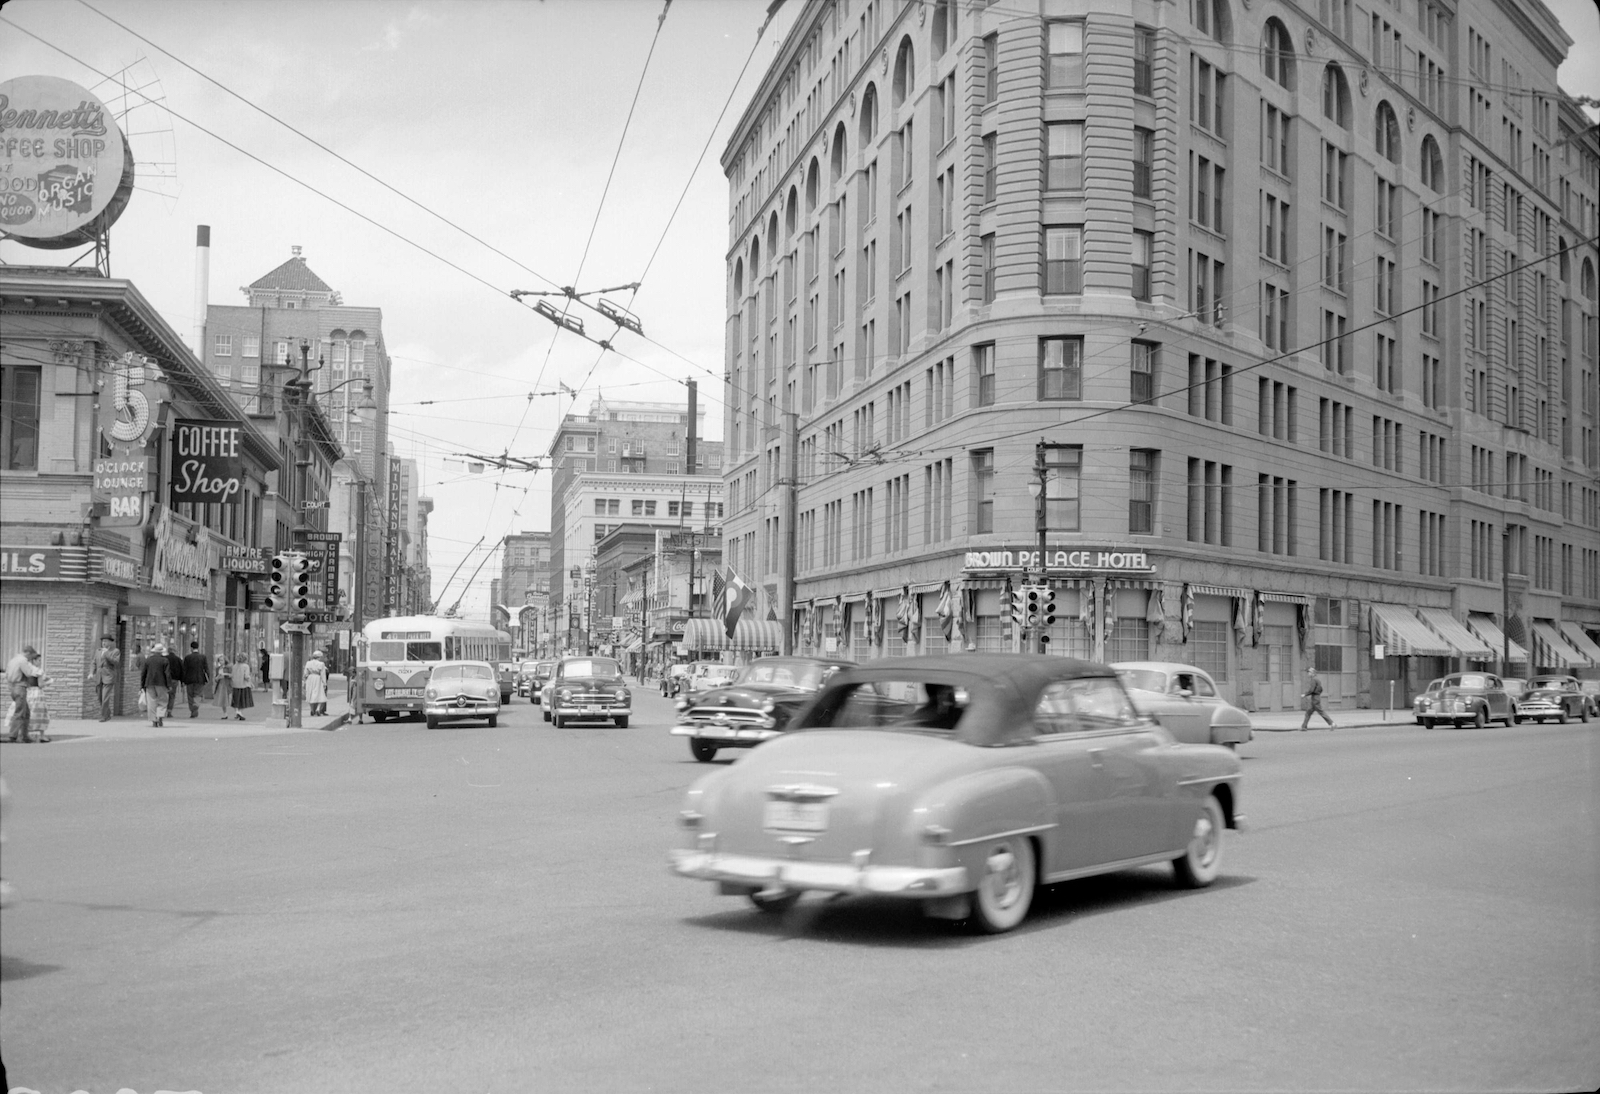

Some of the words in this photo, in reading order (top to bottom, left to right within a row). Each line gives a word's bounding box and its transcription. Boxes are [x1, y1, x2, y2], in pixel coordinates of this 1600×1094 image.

[54, 138, 105, 158] SHOP
[39, 166, 96, 201] ORGAN
[39, 182, 93, 216] MUSIC
[109, 367, 149, 441] 5
[178, 426, 239, 457] COFFEE
[96, 461, 145, 474] O'CLOCK
[96, 477, 145, 489] LOUNGE
[174, 459, 239, 503] Shop
[110, 496, 141, 517] BAR
[391, 463, 400, 531] MIDLAND
[307, 533, 340, 541] BROWN
[222, 558, 266, 571] LIQUORS
[226, 545, 263, 558] EMPIRE
[965, 552, 1012, 567] BROWN
[1019, 551, 1090, 567] PALACE
[1097, 553, 1149, 568] HOTEL
[327, 543, 337, 603] CHAMBERS
[389, 536, 399, 605] SAVINGS
